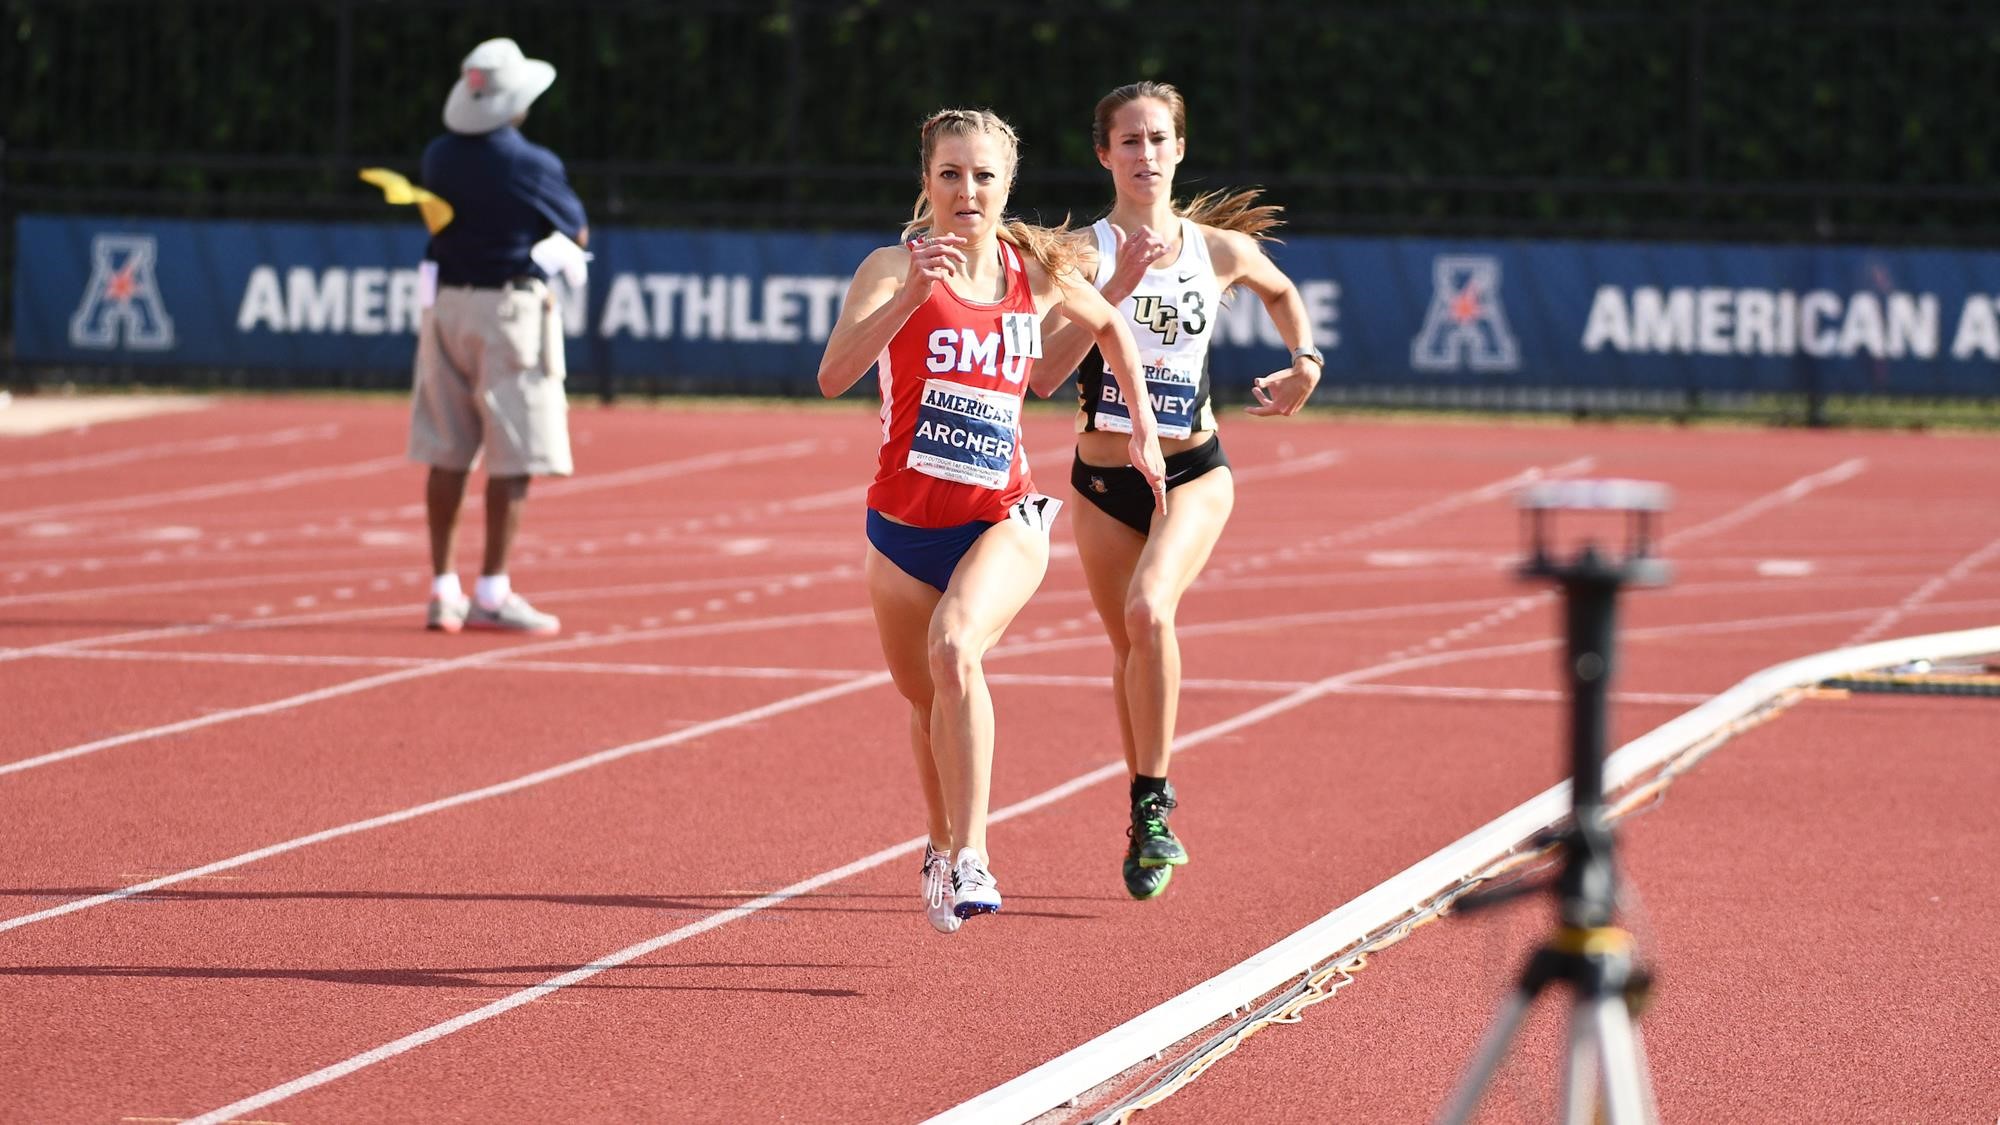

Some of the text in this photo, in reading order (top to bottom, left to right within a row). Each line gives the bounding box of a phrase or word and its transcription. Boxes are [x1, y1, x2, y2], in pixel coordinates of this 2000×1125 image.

[238, 266, 588, 337] AMERN
[1182, 291, 1207, 335] 3
[1005, 315, 1033, 355] 11
[1582, 285, 2000, 361] AMERICAN A
[925, 389, 1013, 424] AMERICAN
[916, 421, 1014, 459] ARCHER
